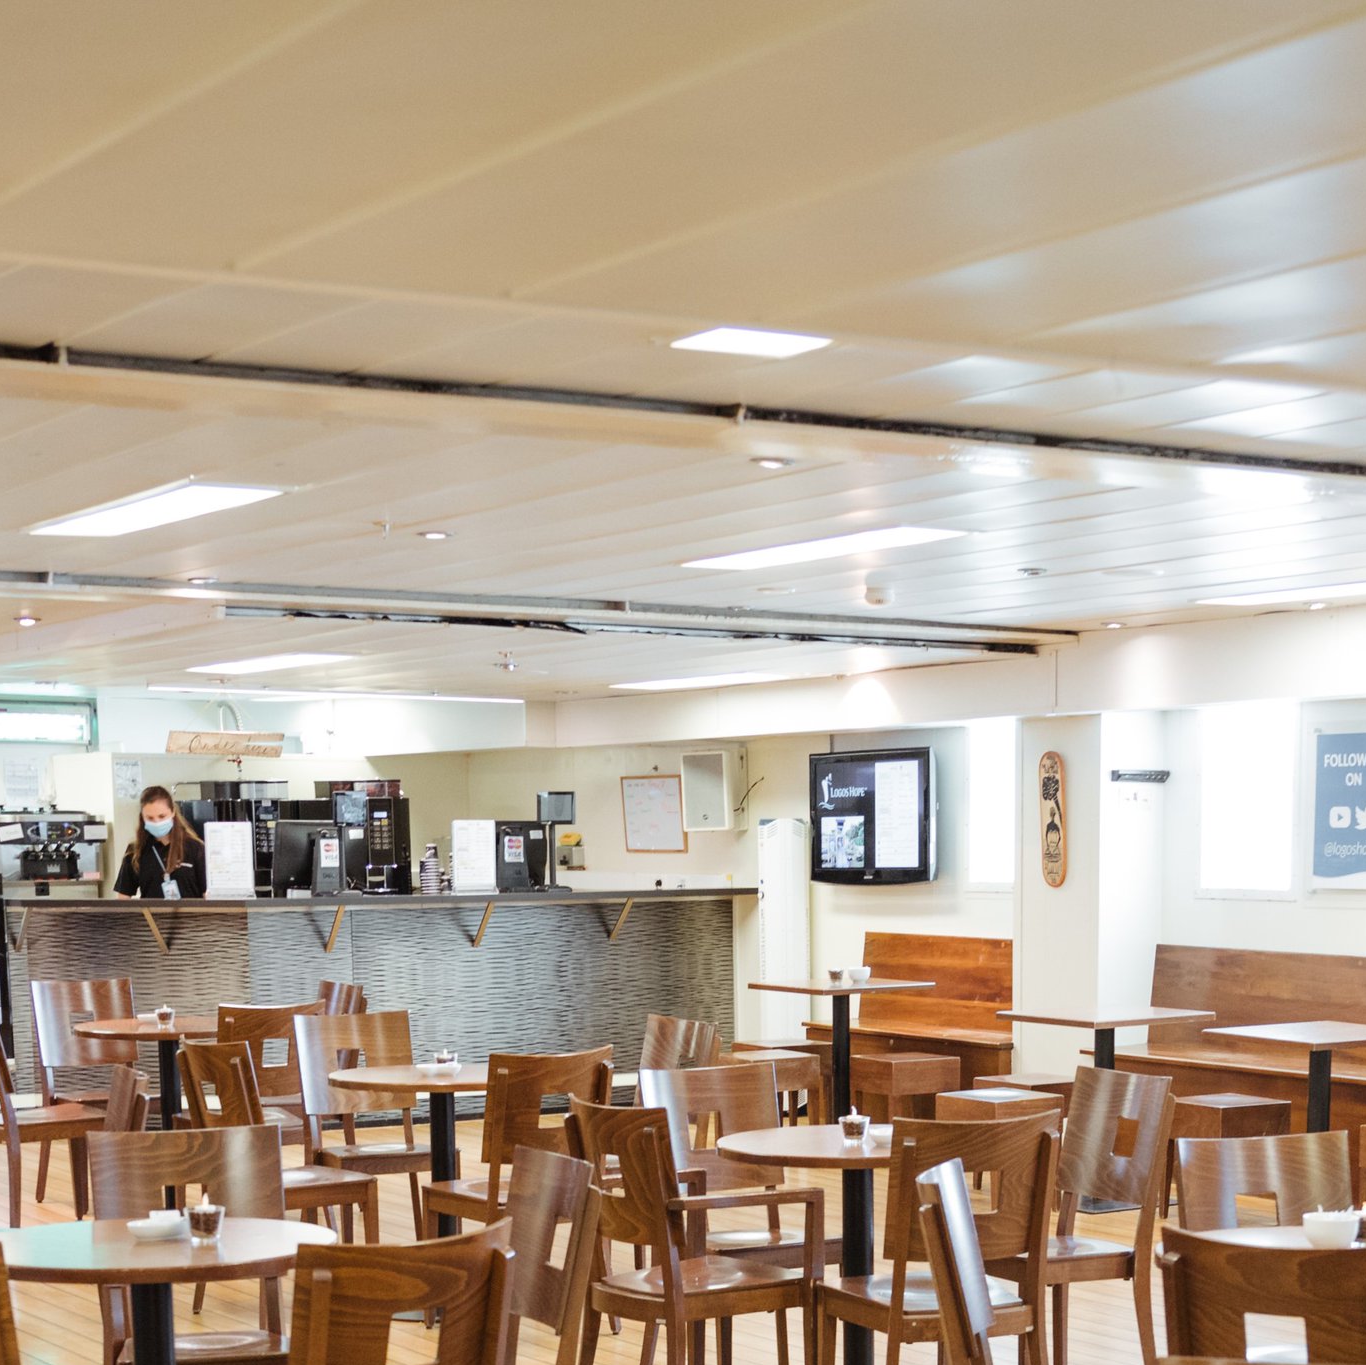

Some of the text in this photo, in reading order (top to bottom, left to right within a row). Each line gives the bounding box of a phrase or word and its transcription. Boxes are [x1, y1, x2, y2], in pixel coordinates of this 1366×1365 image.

[1345, 772, 1363, 786] ON
[830, 786, 866, 798] LOGOS HOPE
